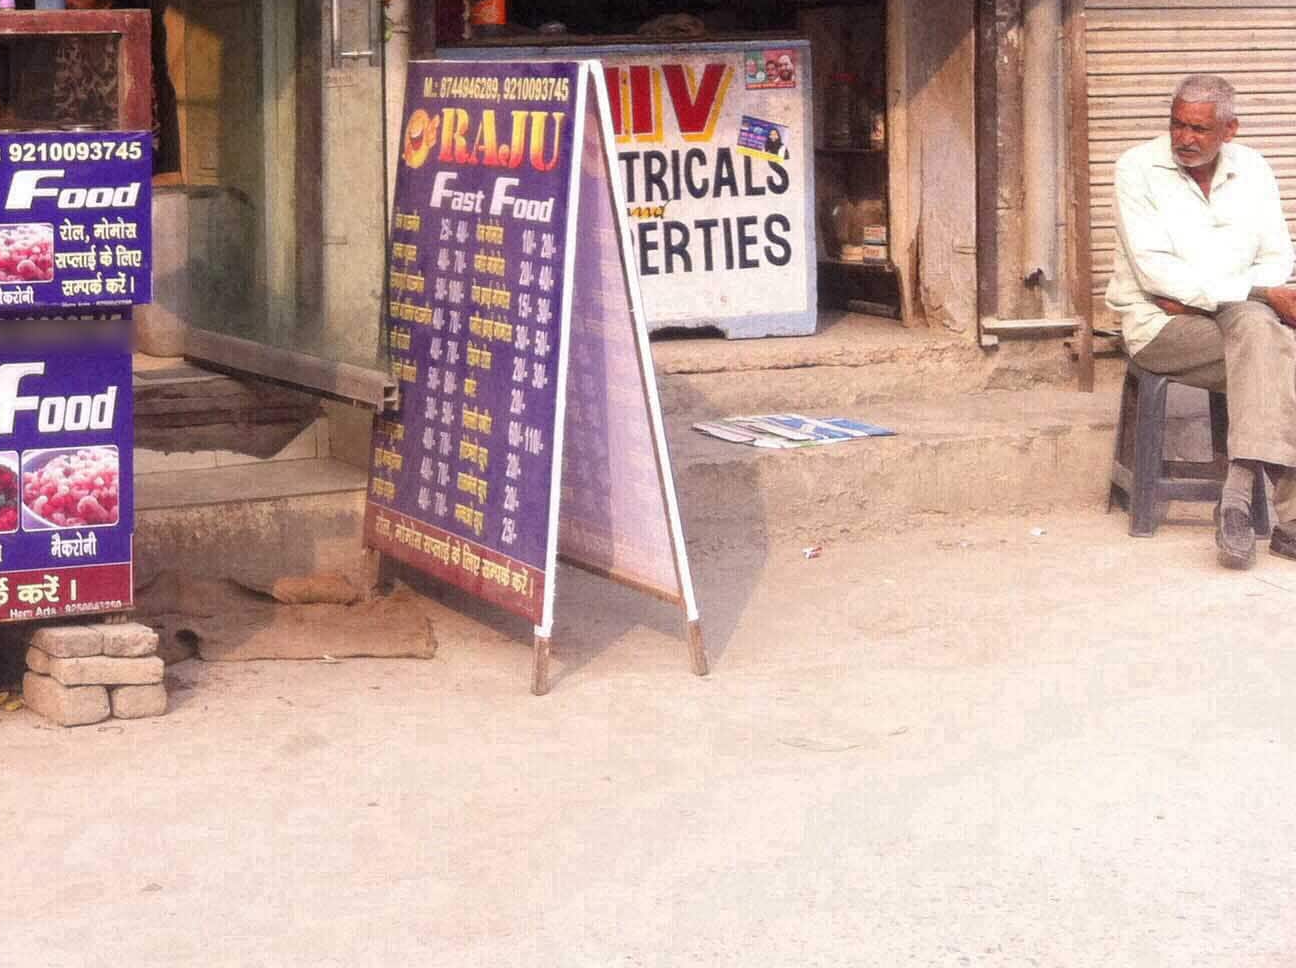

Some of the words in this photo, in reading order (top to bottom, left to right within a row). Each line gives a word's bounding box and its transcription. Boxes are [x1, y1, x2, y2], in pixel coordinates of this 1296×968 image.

[8, 141, 142, 162] 9210093745
[438, 107, 565, 172] RAJU
[4, 168, 141, 210] Food
[429, 171, 485, 212] Fast
[489, 176, 555, 223] Food
[93, 216, 137, 240] मोमोस
[55, 244, 97, 271] सप्लाई
[99, 245, 112, 267] के
[115, 244, 142, 268] लिए
[61, 271, 103, 296] सम्पर्क
[51, 531, 97, 559] मैकरोनी
